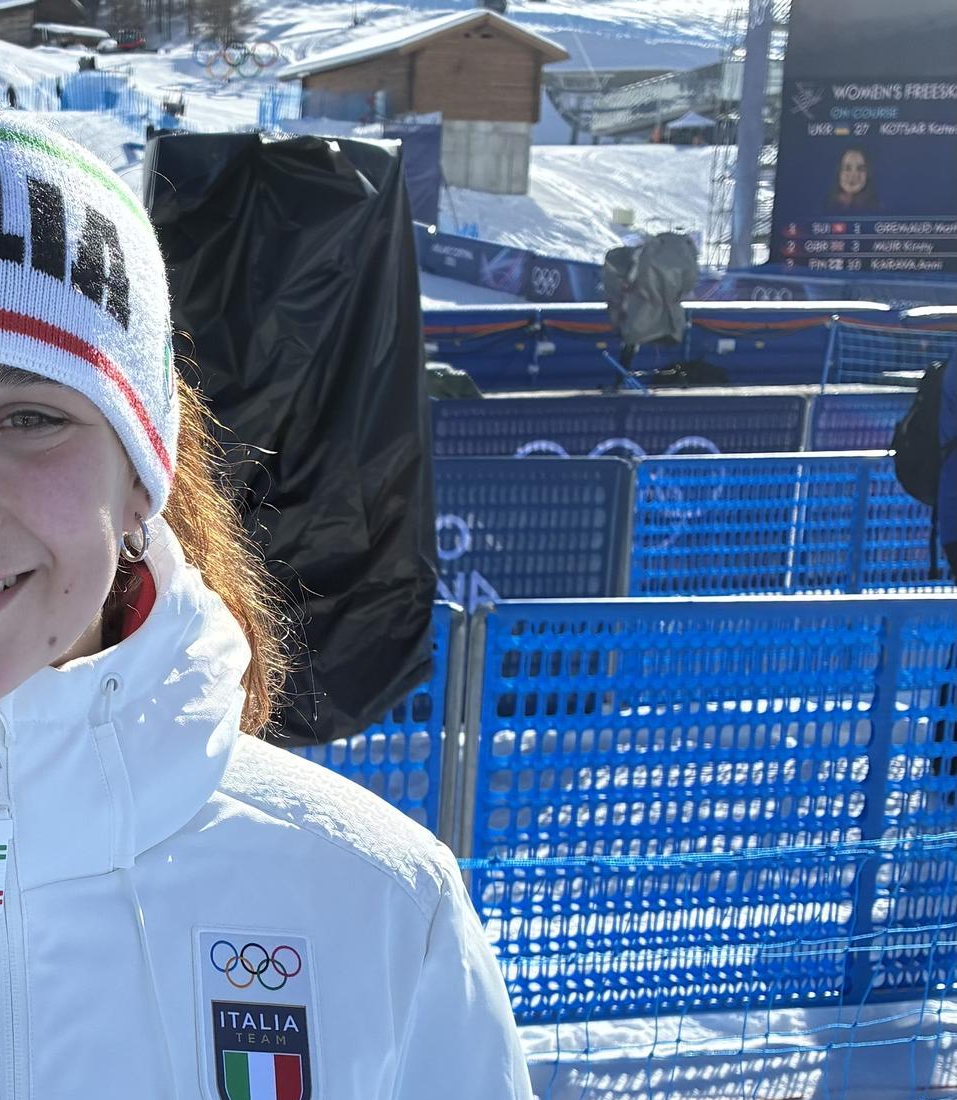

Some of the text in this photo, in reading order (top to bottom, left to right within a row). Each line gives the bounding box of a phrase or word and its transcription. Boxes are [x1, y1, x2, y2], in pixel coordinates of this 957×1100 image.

[833, 84, 902, 100] WOMEN'S
[808, 122, 833, 136] UKR
[219, 1010, 300, 1033] ITALIA
[235, 1032, 287, 1046] TEAM
